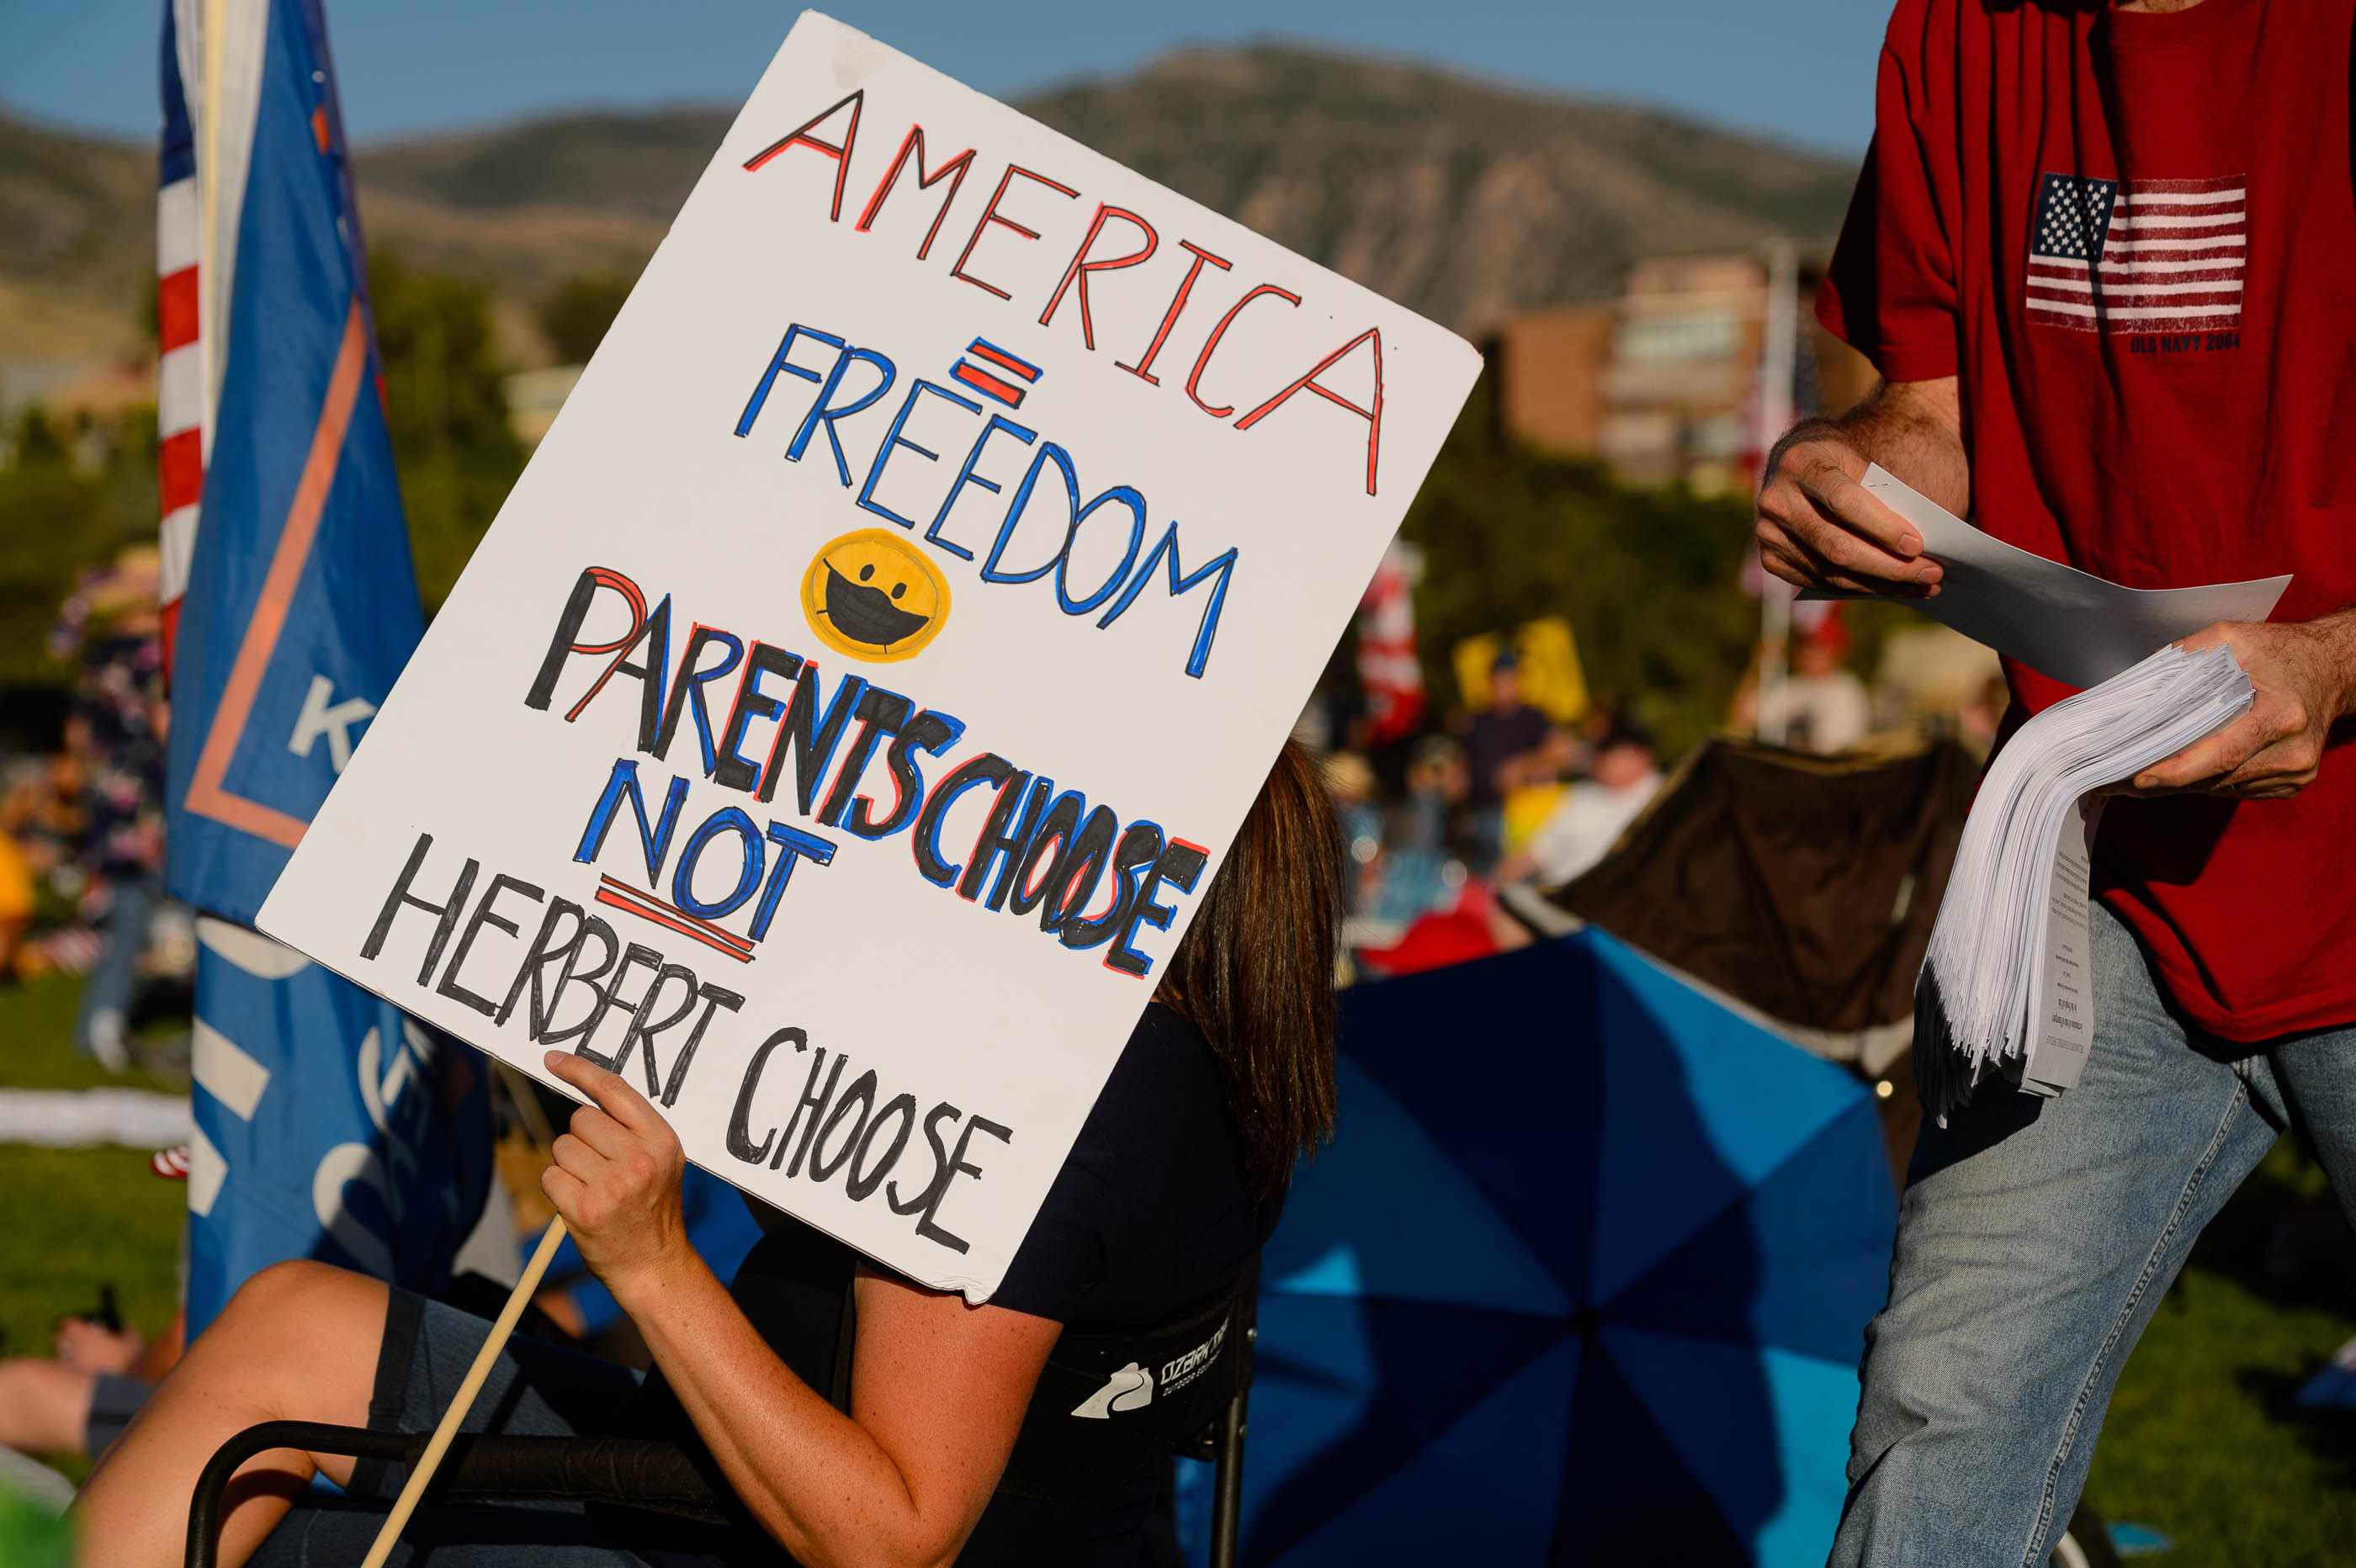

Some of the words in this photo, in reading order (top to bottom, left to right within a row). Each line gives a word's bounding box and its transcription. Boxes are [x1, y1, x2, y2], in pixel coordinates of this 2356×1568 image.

[743, 88, 1384, 497] AMERICA
[2130, 336, 2157, 353] OLD
[2161, 334, 2201, 352] NAVY
[2205, 331, 2241, 351] 2004
[734, 323, 1239, 679] FREEDOM
[524, 565, 966, 841] PARENTS
[912, 752, 1210, 979] CHOOSE
[573, 758, 839, 942] NOT
[360, 833, 746, 1109] HERBERT
[726, 1026, 1013, 1255] CHOOSE
